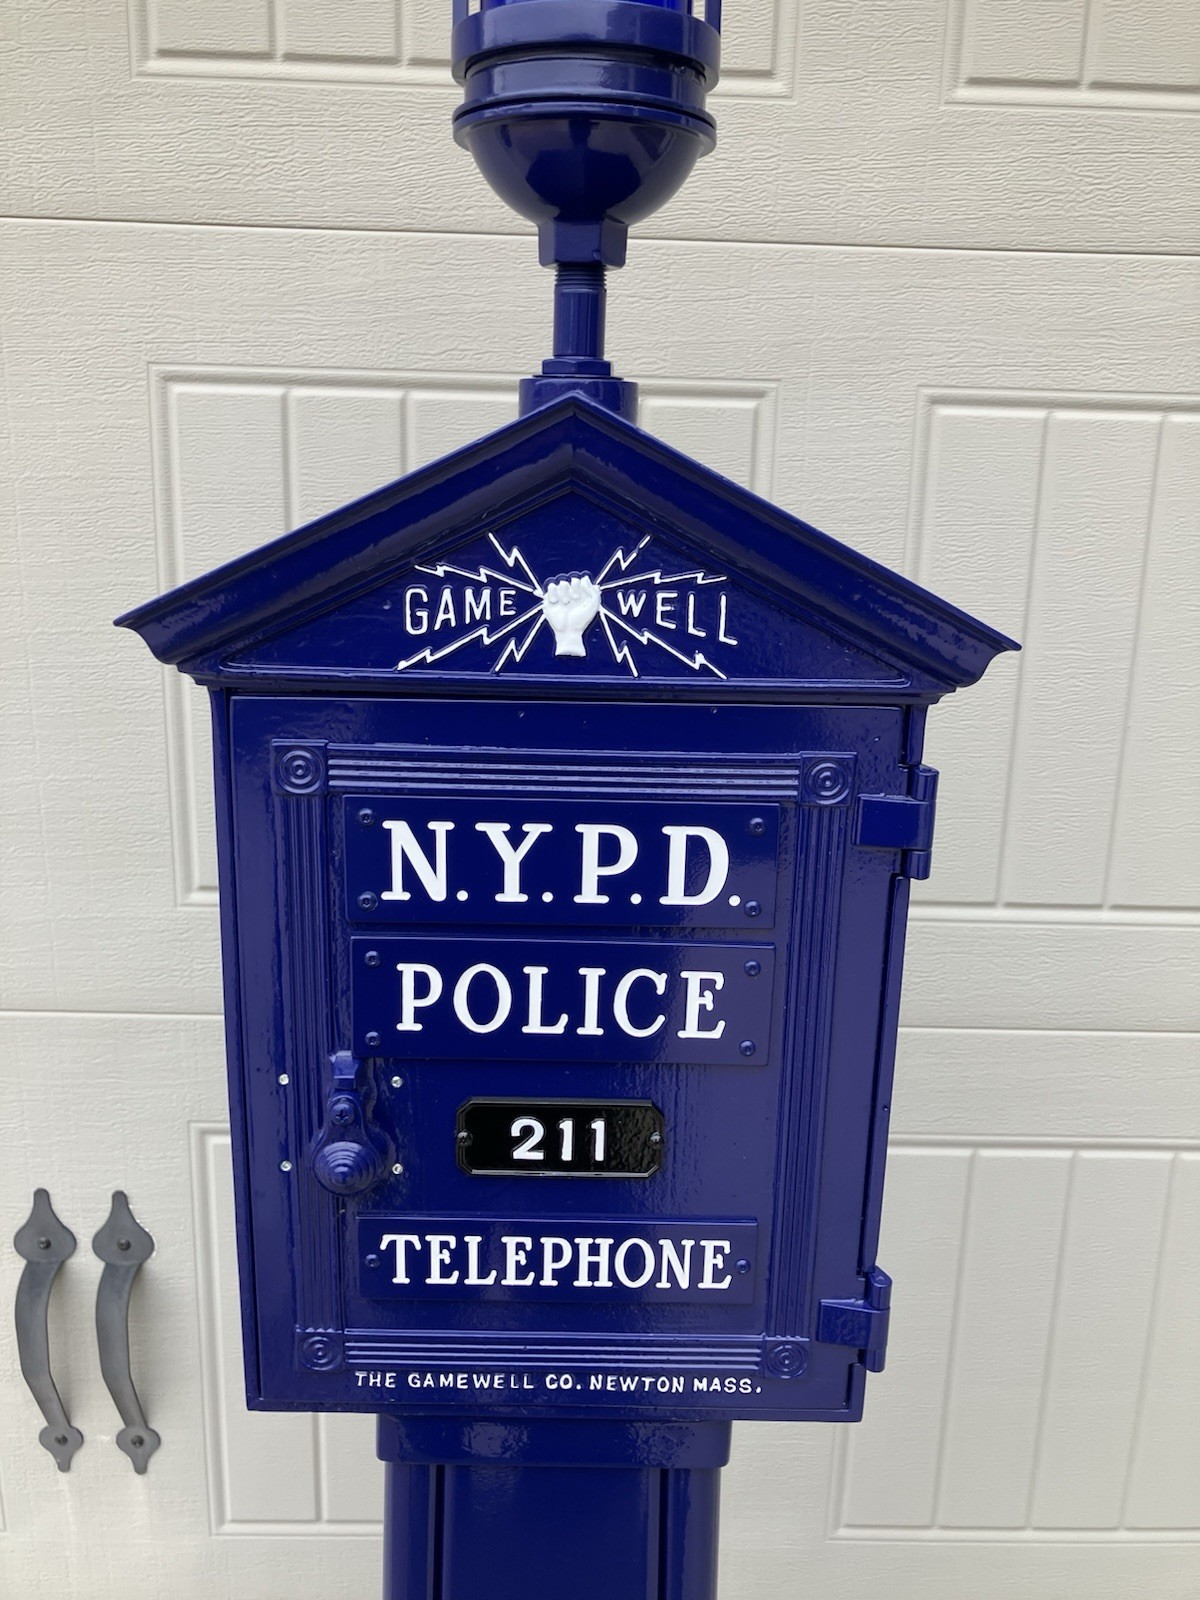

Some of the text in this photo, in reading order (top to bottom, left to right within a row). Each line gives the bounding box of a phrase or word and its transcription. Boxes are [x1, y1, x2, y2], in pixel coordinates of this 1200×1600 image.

[404, 587, 739, 646] GAME WELL
[380, 820, 742, 908] N.Y.P.D.
[396, 962, 727, 1040] POLICE
[510, 1118, 606, 1162] 211
[379, 1233, 733, 1290] TELEPHONE
[354, 1371, 763, 1396] THE GAMEWELL CO. NEWTON MASS.
